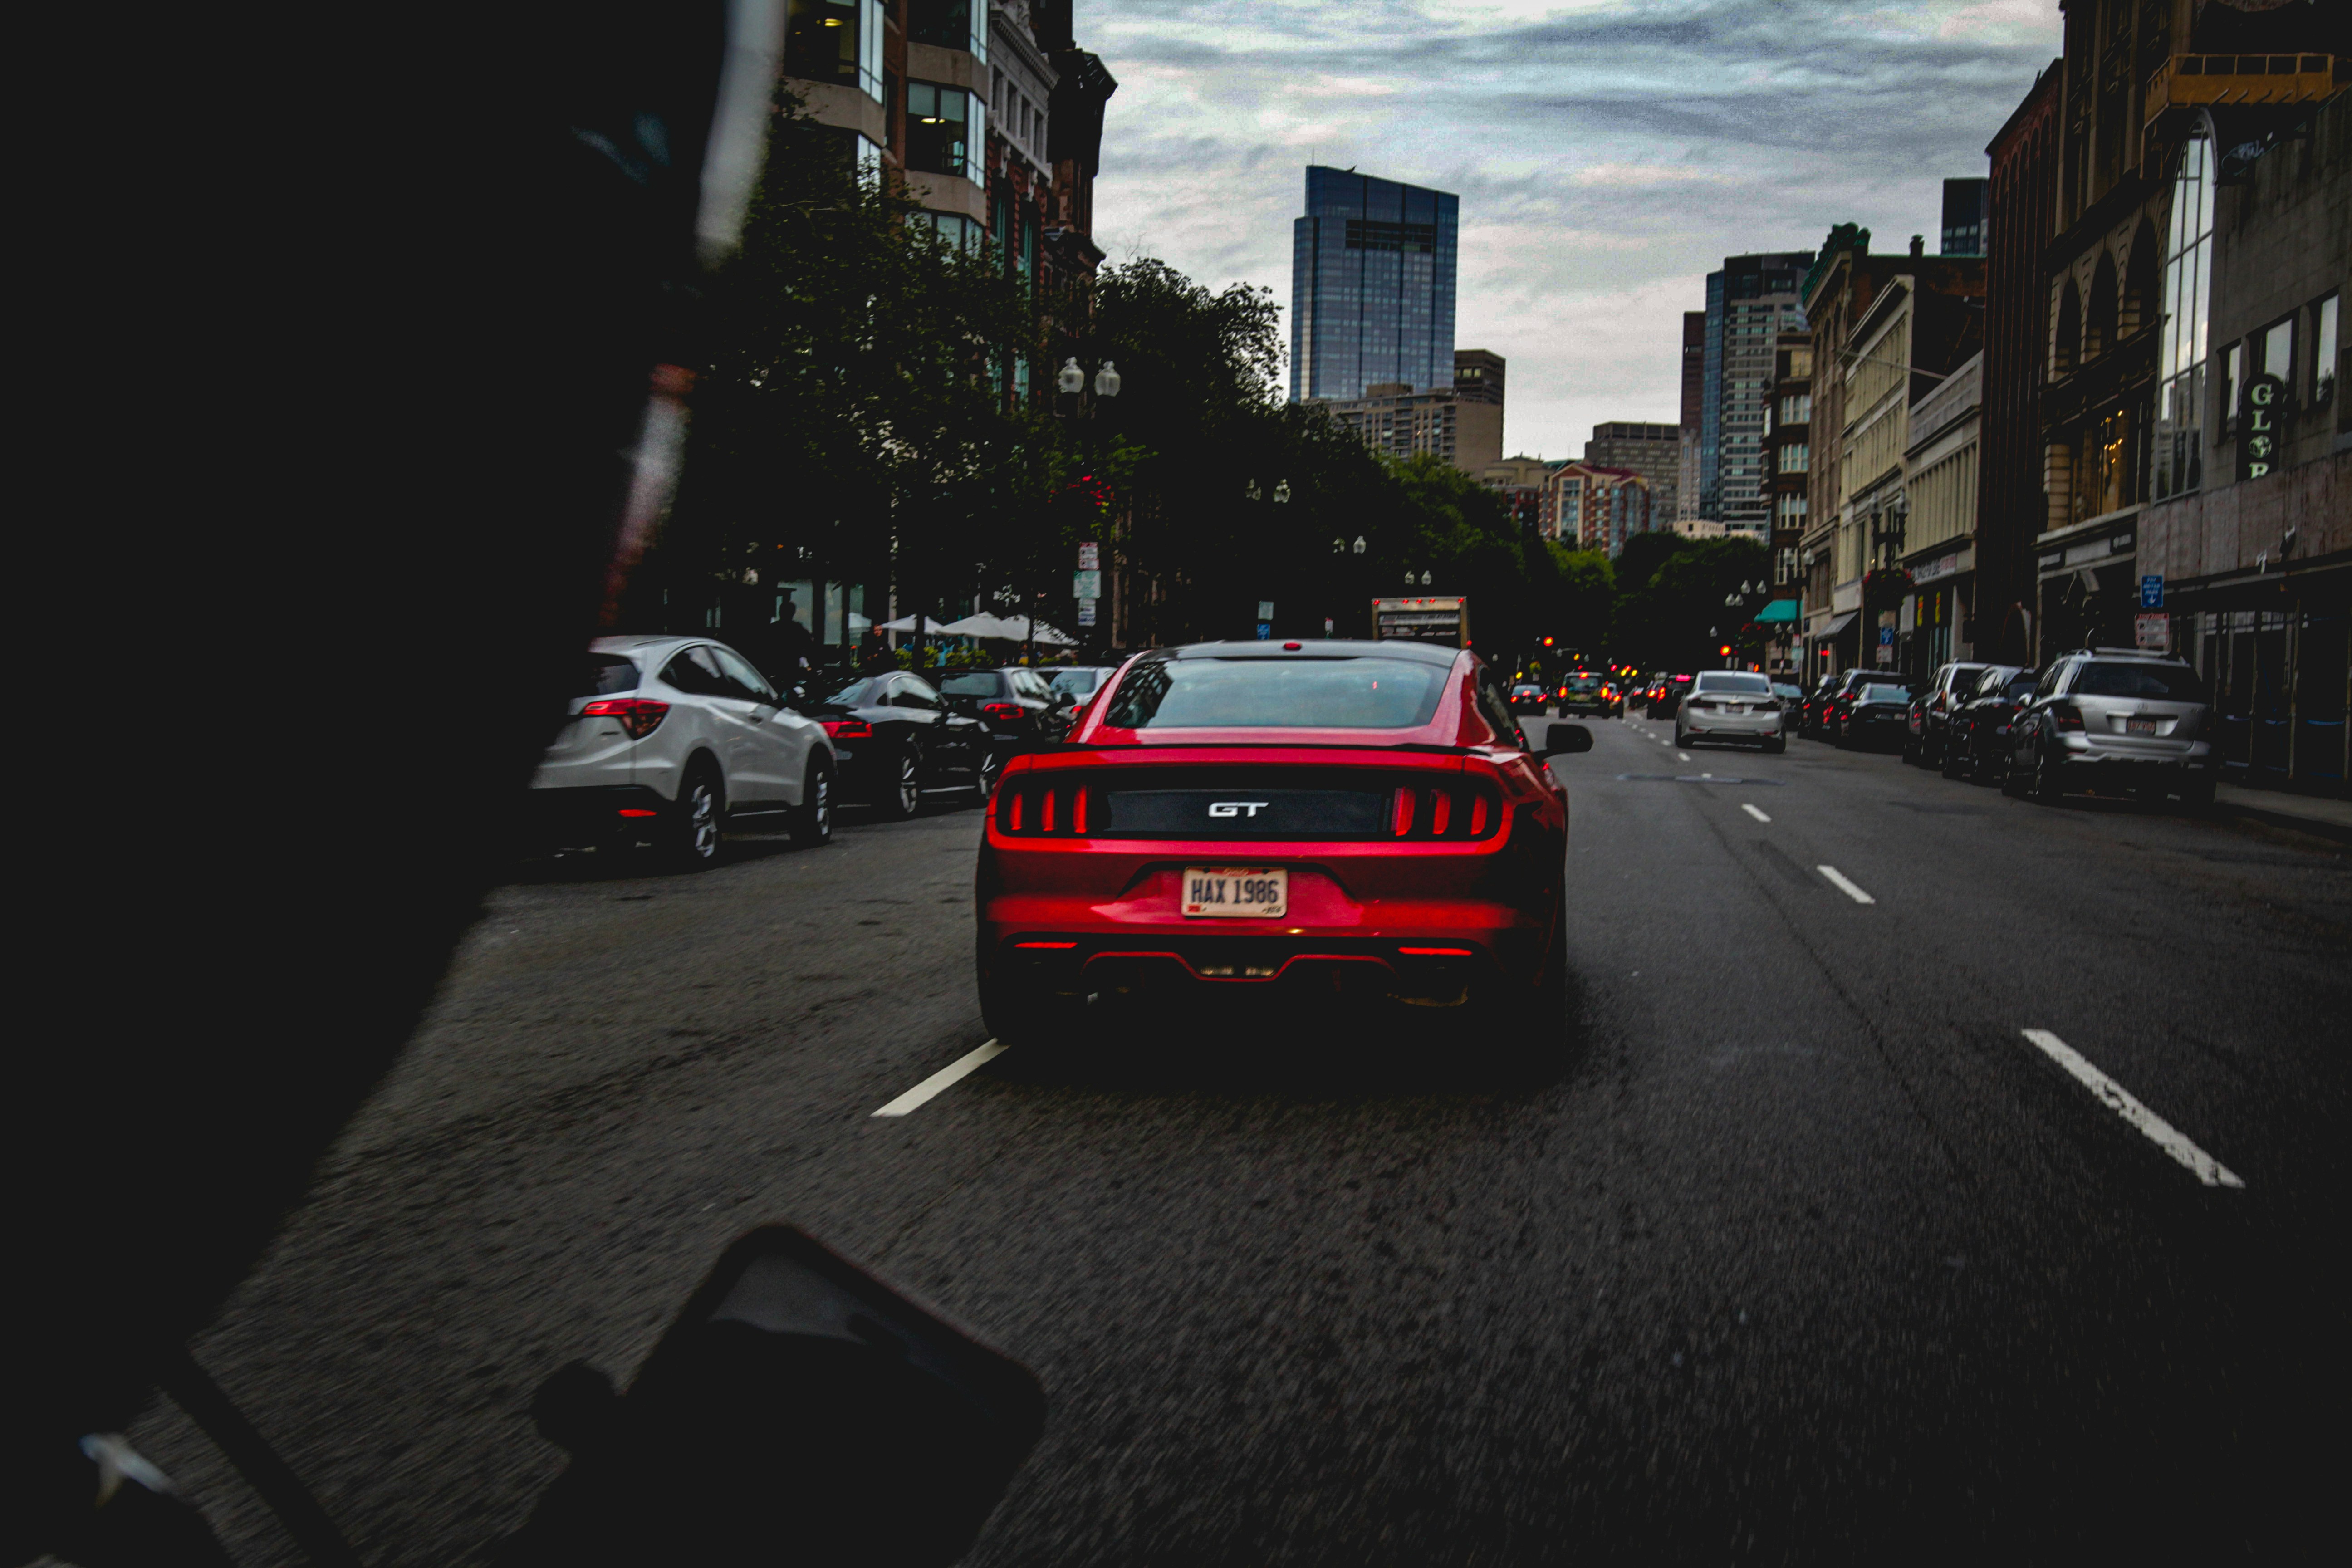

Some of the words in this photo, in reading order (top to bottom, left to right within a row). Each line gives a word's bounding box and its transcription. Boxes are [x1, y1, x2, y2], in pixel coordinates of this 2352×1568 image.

[1208, 802, 1269, 817] GT
[1191, 879, 1226, 903] HAX
[1233, 879, 1279, 903] 1986
